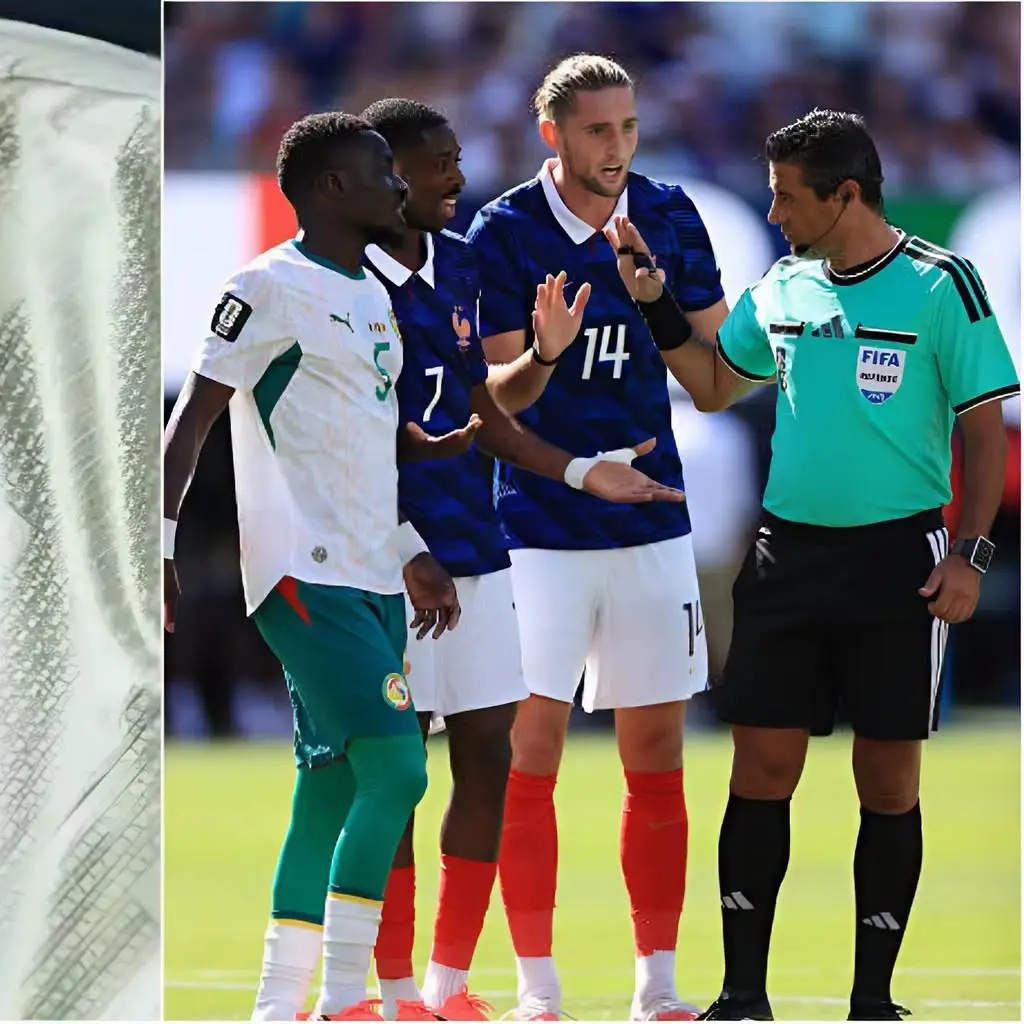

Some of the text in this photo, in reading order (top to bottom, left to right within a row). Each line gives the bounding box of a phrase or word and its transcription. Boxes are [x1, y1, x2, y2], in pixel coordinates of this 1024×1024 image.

[373, 342, 392, 401] 5
[581, 324, 630, 380] 14
[862, 350, 900, 367] FIFA
[422, 366, 444, 422] 7
